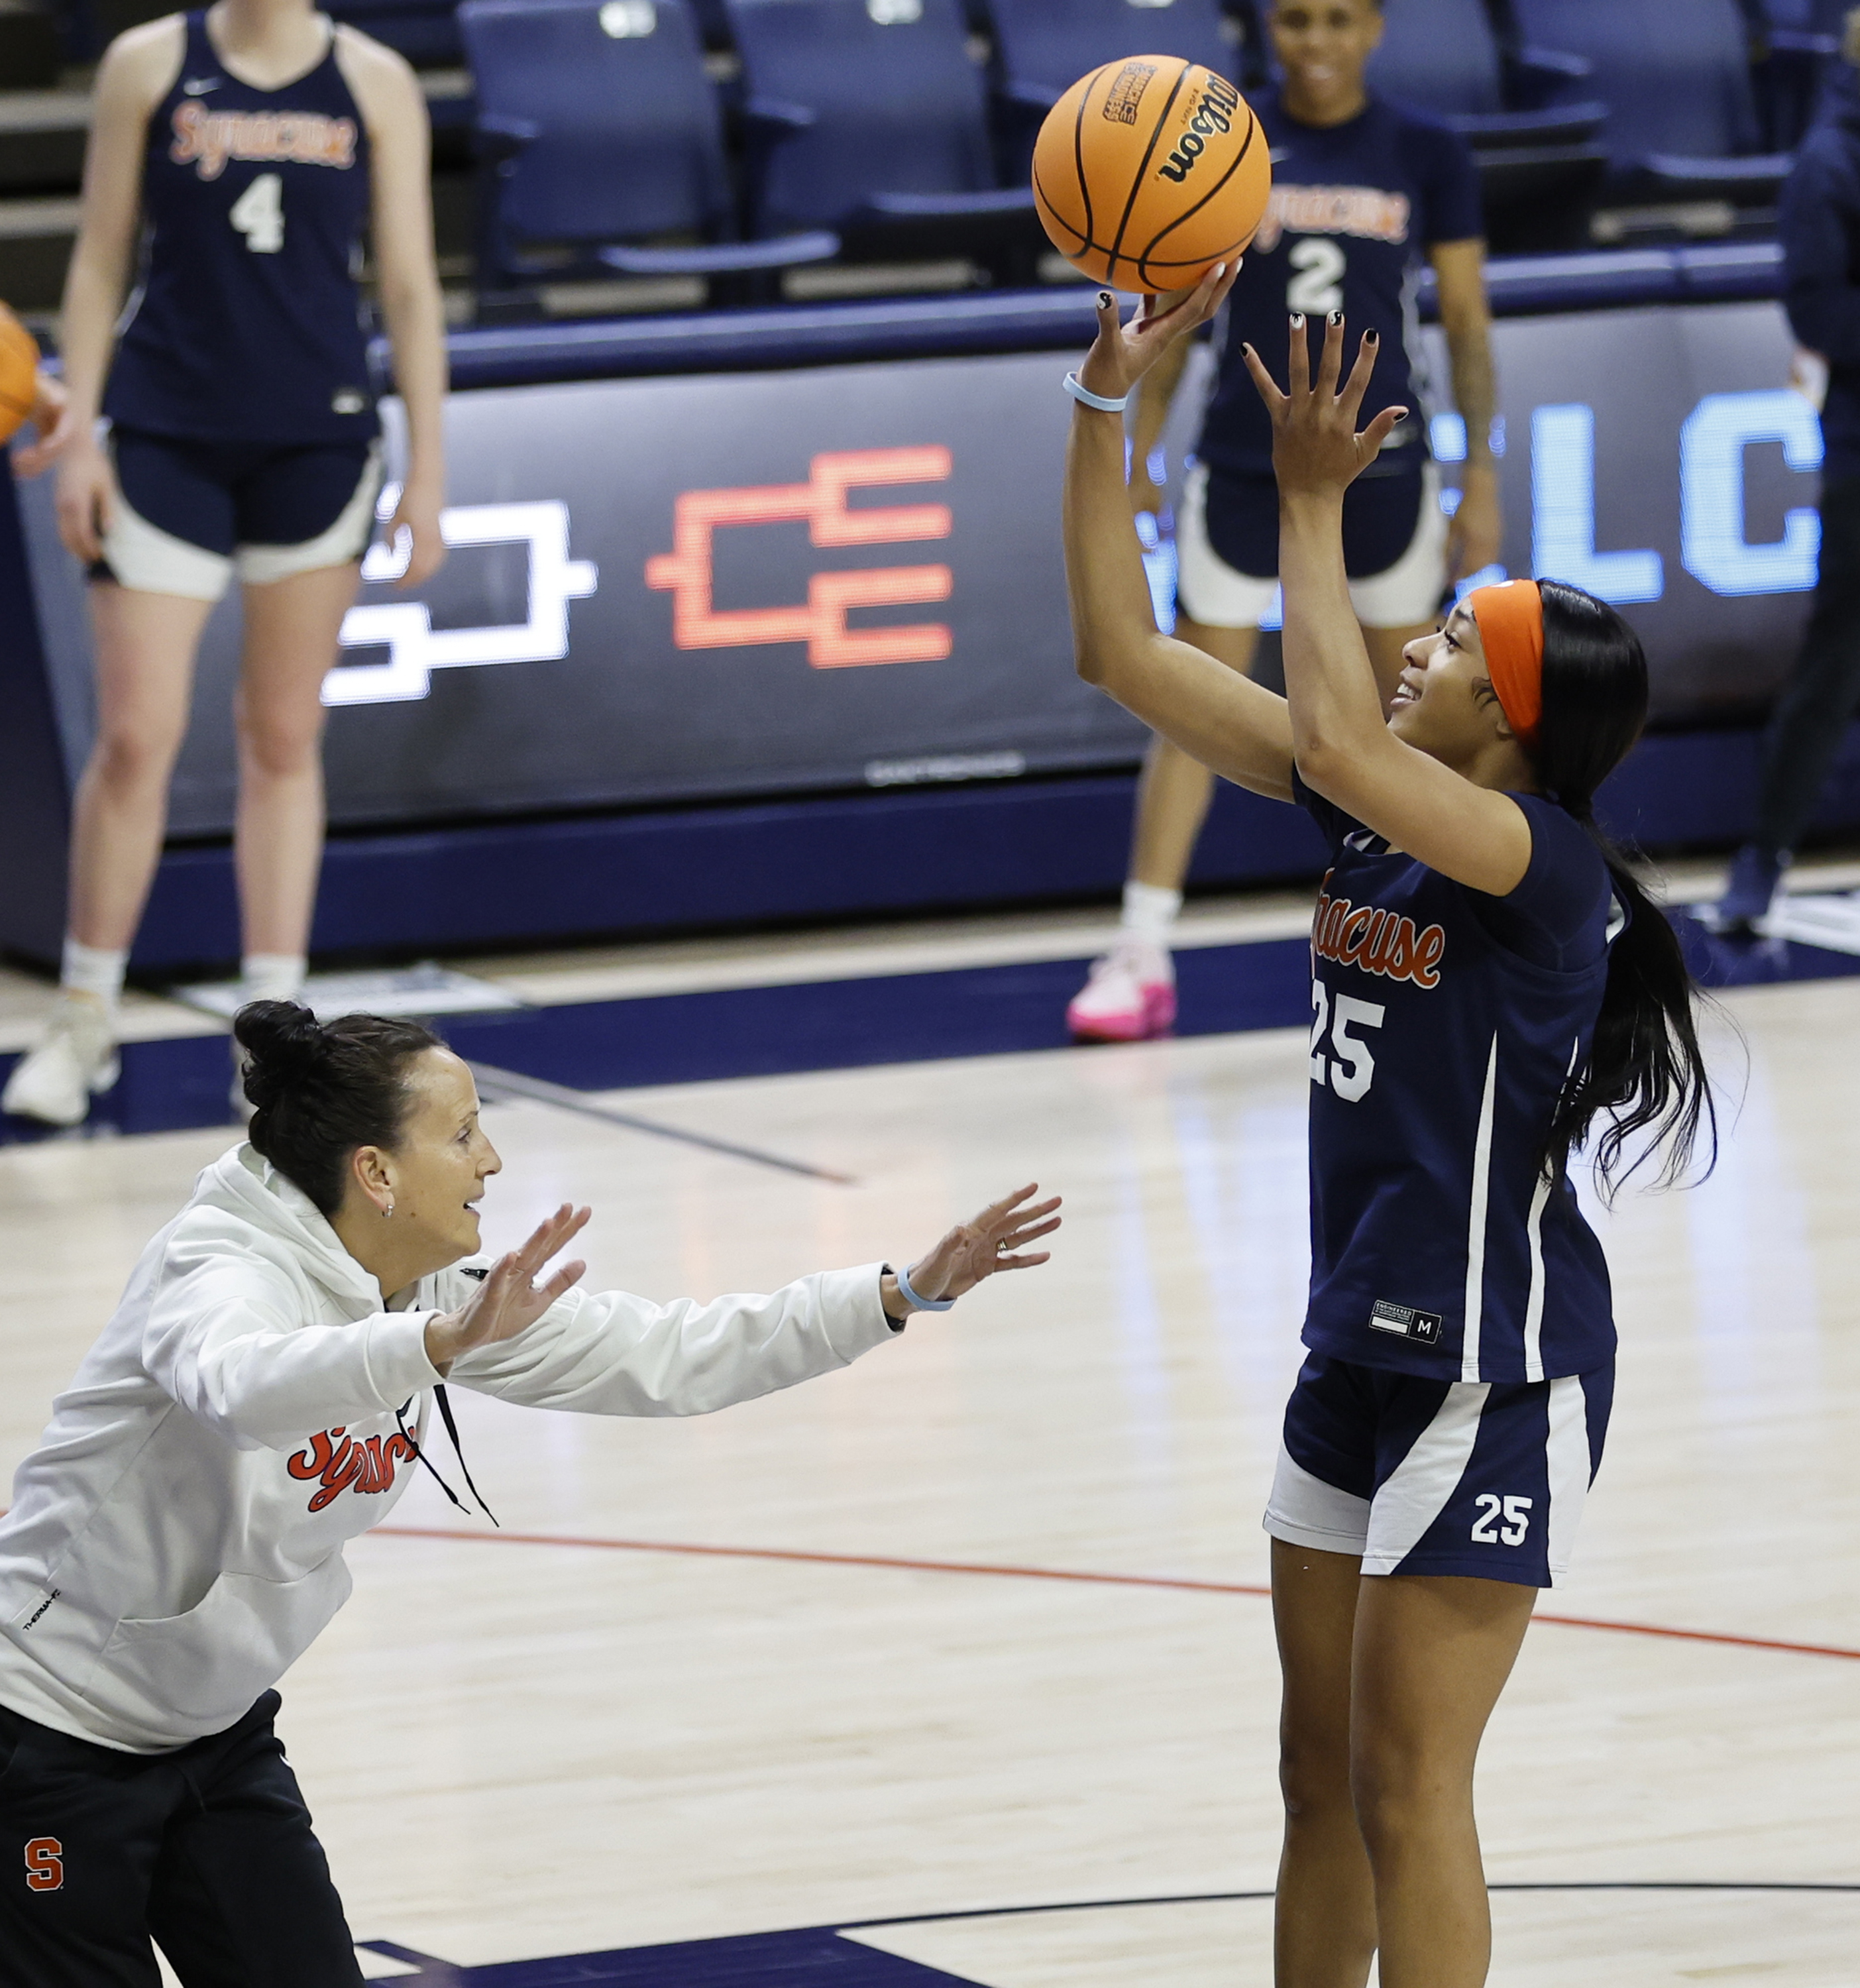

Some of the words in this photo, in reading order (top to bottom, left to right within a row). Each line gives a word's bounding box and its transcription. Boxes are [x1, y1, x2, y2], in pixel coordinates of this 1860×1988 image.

[1158, 74, 1238, 184] Wilson
[229, 172, 285, 253] 4
[1287, 238, 1346, 315] 2
[1310, 978, 1386, 1103] 25
[1417, 1319, 1432, 1335] M
[1471, 1493, 1533, 1547] 25
[25, 1836, 64, 1892] S
